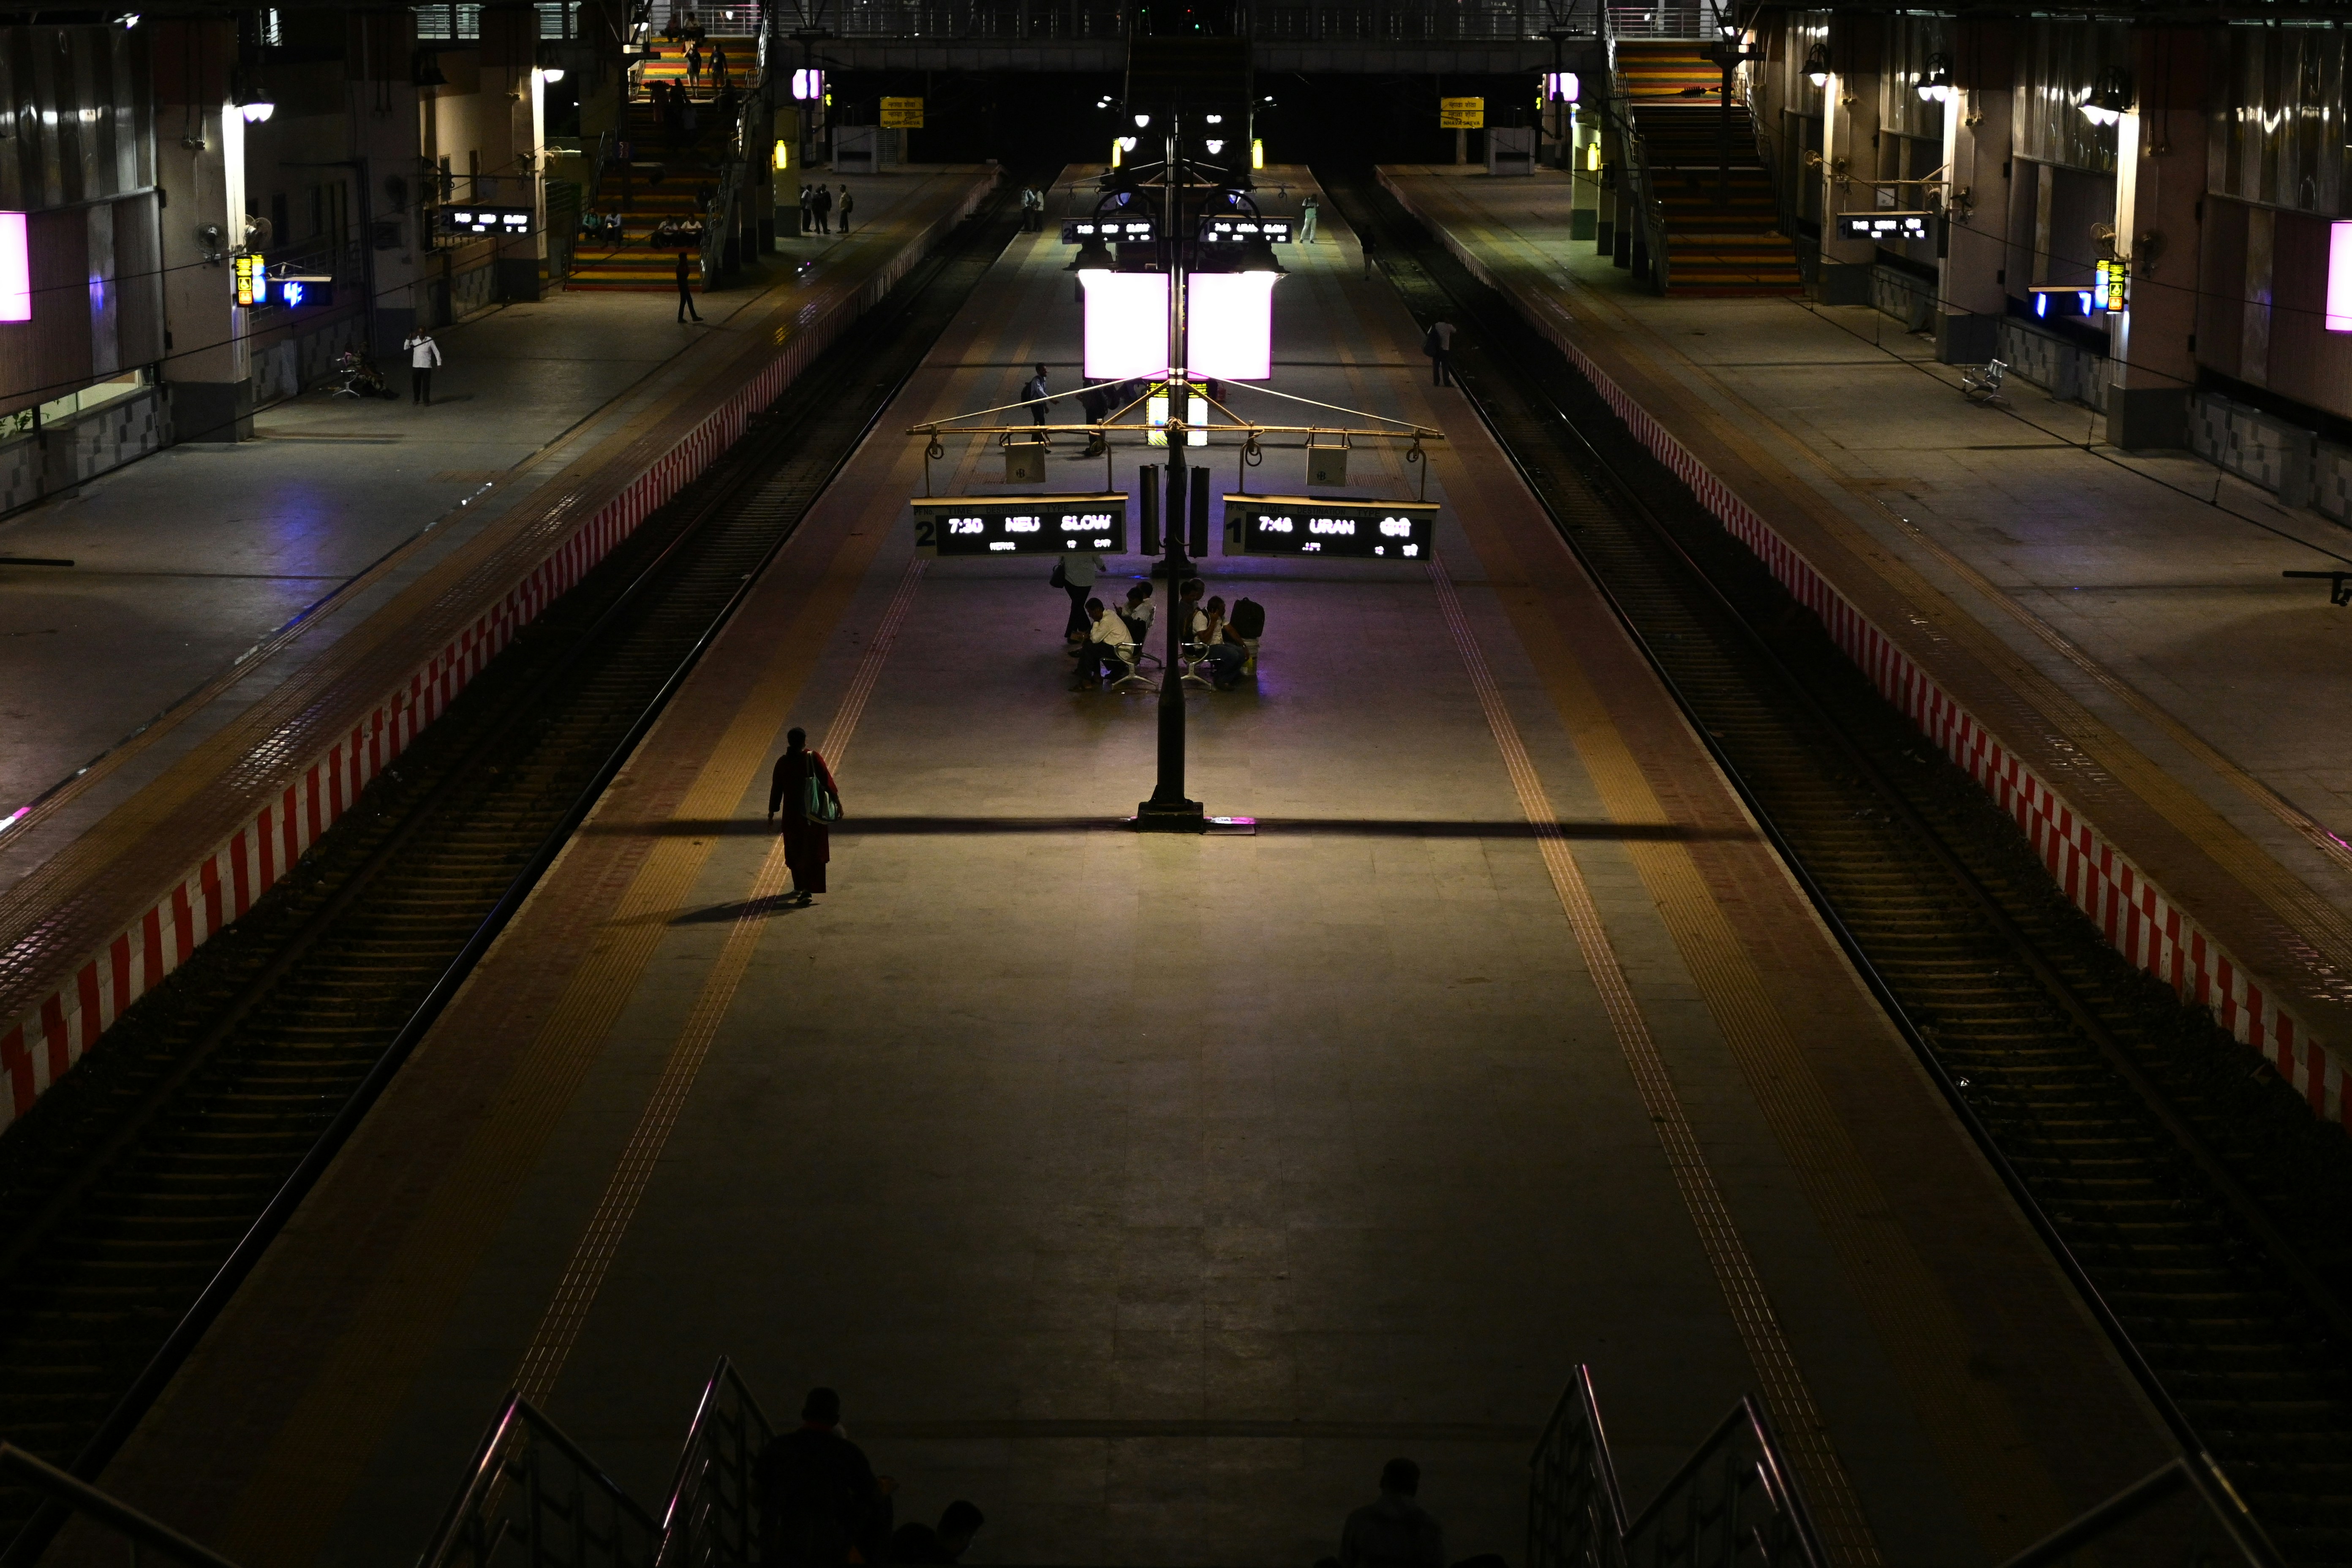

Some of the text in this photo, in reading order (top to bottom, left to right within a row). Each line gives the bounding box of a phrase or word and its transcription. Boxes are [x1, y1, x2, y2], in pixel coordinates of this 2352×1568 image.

[915, 521, 936, 546] 2
[949, 514, 1111, 534] 7:30 NEU SLOW
[1226, 518, 1241, 543] 1
[1309, 518, 1355, 534] URAN
